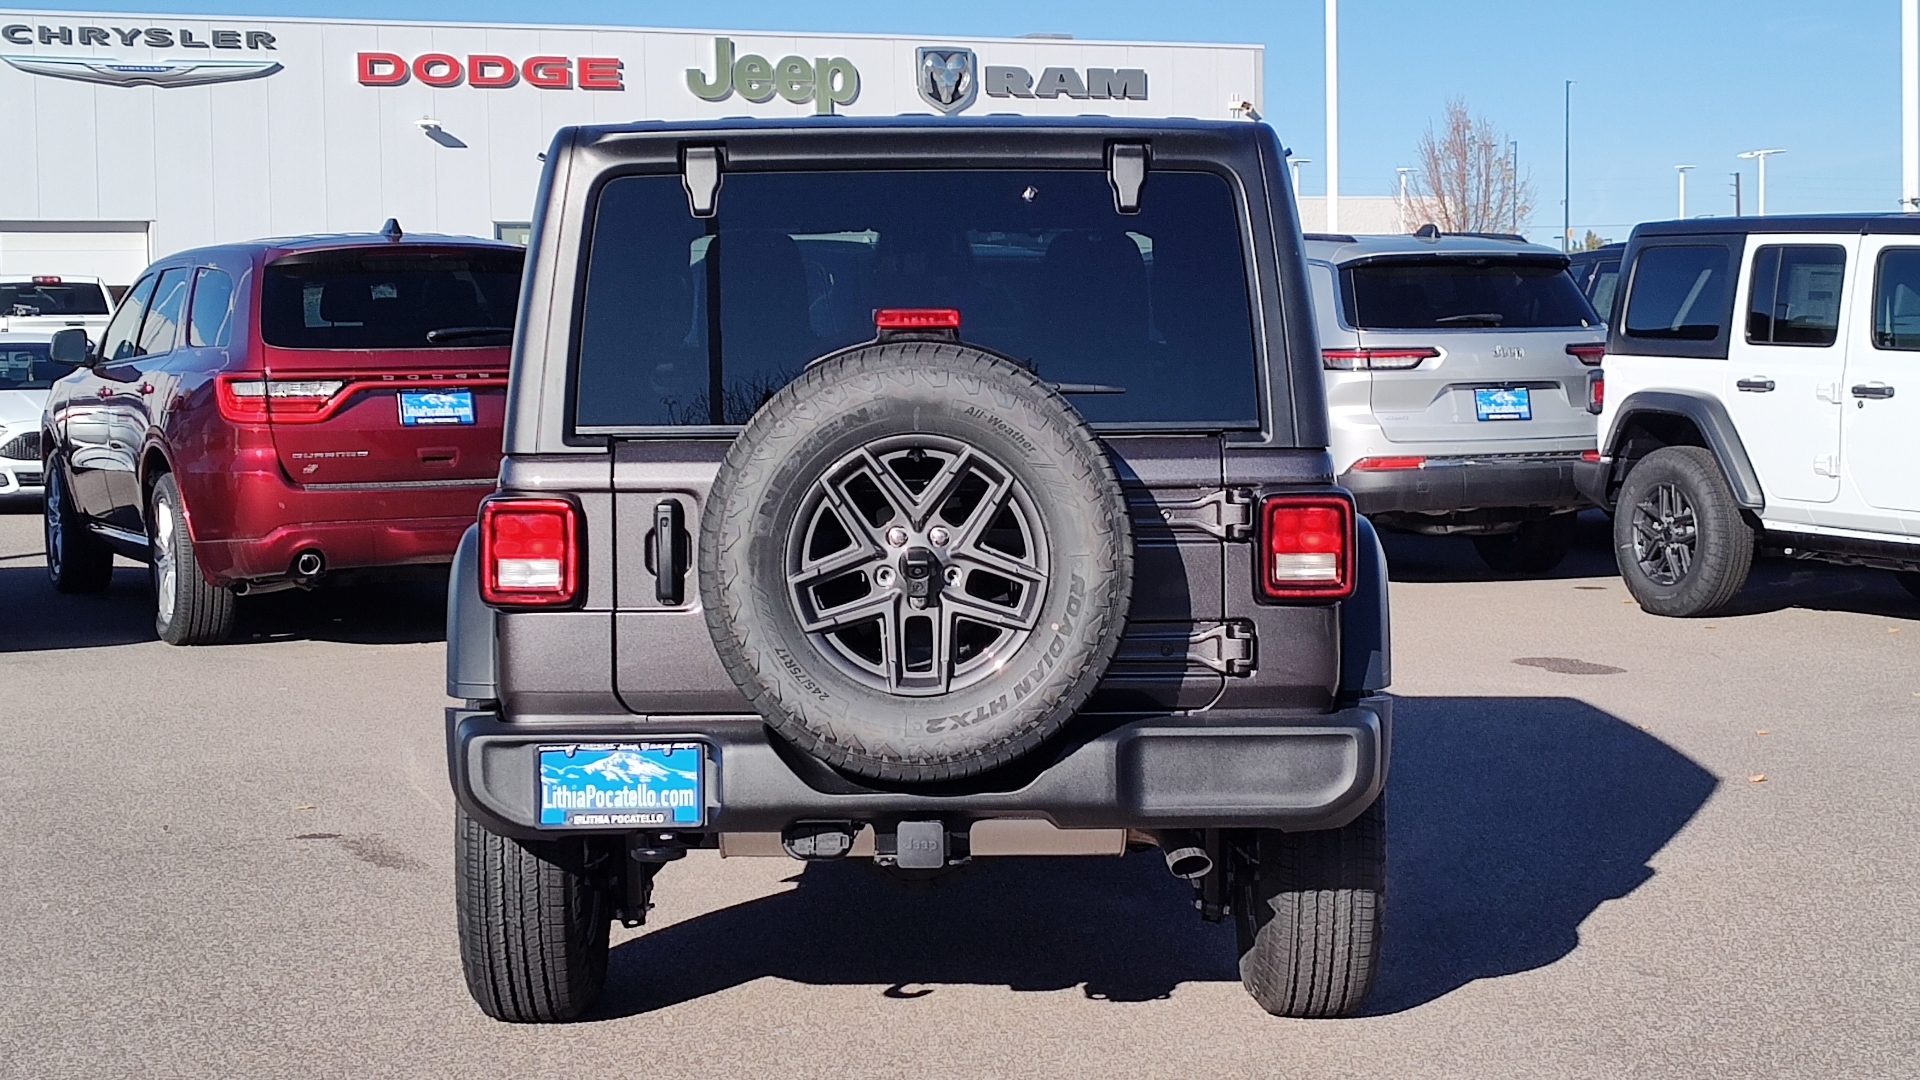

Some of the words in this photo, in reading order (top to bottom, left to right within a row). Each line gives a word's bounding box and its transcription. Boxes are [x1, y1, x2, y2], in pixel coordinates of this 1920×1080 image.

[1, 23, 277, 50] CHRYSLER
[357, 52, 624, 91] DODGE
[686, 37, 859, 116] Jeep
[985, 66, 1148, 101] RAM
[964, 406, 1037, 452] All-Weather
[1013, 574, 1086, 701] ROADIAN
[775, 647, 830, 701] 245/75R17
[926, 695, 1007, 734] HTX2
[543, 784, 694, 808] LithiaPocatello.com
[581, 814, 610, 825] LITHIA
[611, 813, 664, 824] POCATELLO
[903, 837, 938, 852] Jeep
